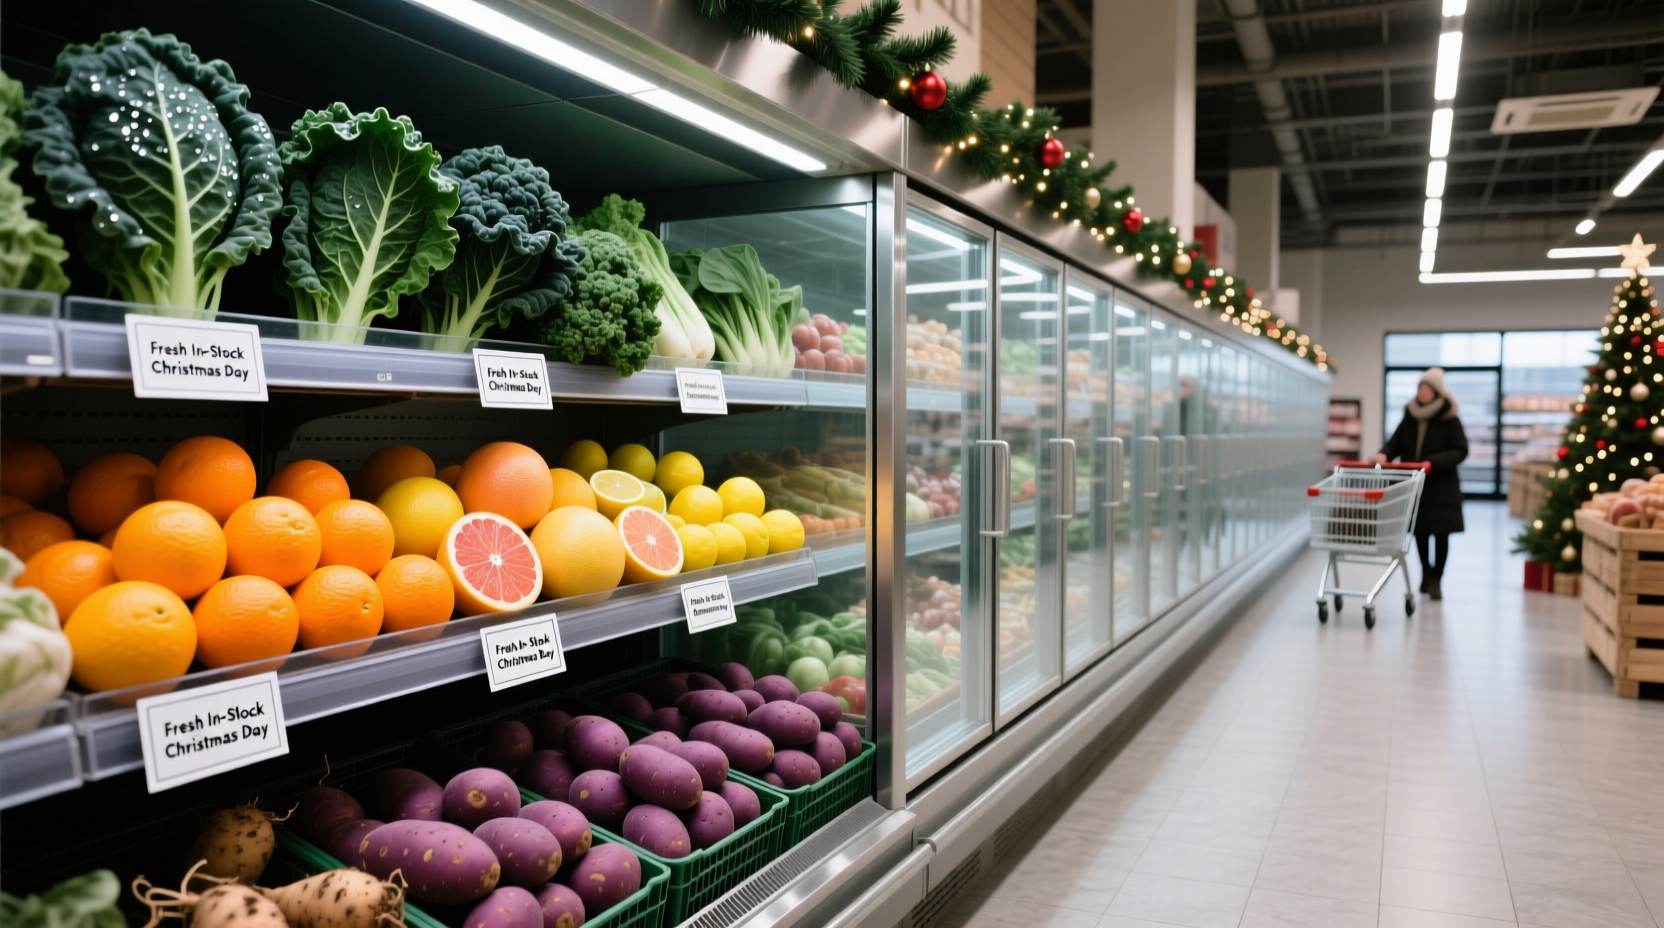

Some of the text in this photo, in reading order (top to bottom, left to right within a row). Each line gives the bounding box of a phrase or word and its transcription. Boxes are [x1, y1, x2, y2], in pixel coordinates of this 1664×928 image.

[151, 341, 187, 356] Fresh
[152, 360, 249, 382] Christmas Day
[164, 714, 204, 738] Fresh
[165, 723, 269, 759] Christmas Day
